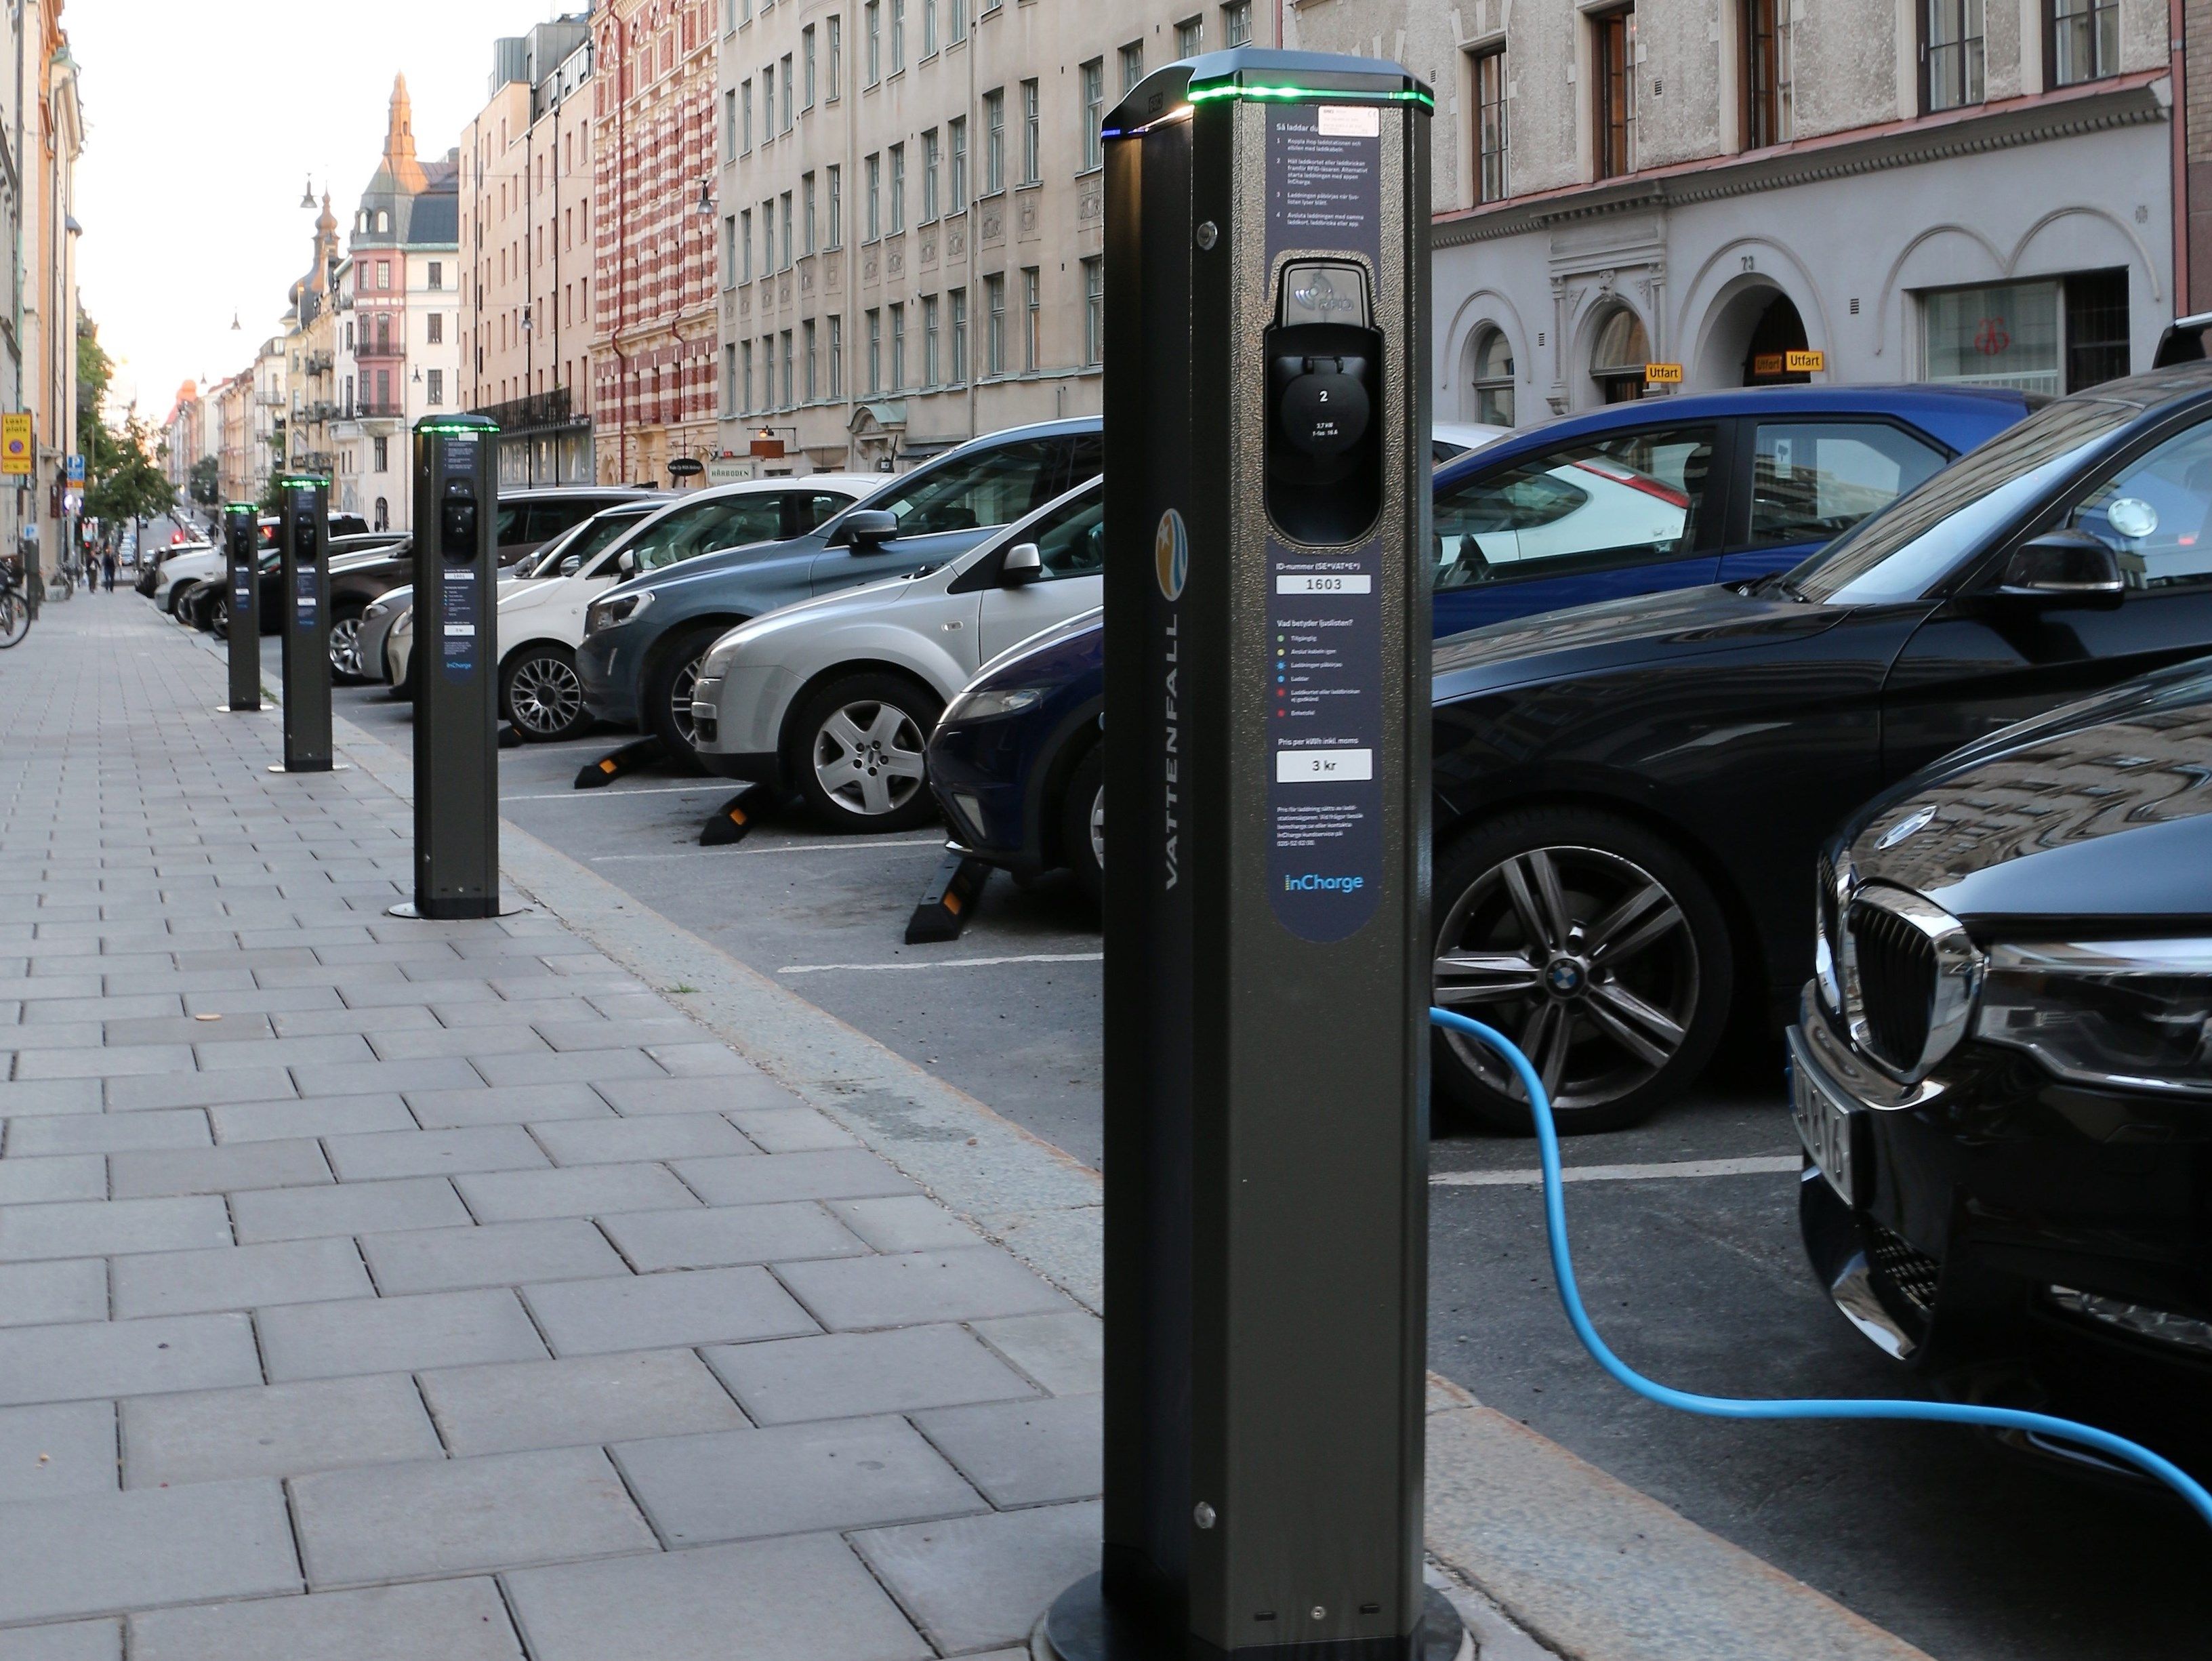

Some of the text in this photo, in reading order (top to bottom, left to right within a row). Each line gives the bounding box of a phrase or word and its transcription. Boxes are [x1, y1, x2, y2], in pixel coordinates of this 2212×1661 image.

[1276, 123, 1286, 131] Så
[1286, 123, 1309, 132] laddar
[1790, 354, 1820, 367] Utfart
[1650, 367, 1679, 379] Utfart
[1319, 390, 1328, 402] 2
[1276, 562, 1314, 571] ID-nummer
[1306, 579, 1342, 590] 1603
[1277, 619, 1291, 628] Vad
[1292, 619, 1319, 628] betyder
[1166, 613, 1179, 890] VATTENFALL
[1312, 760, 1337, 771] 3 kr
[1285, 874, 1364, 893] inCharge
